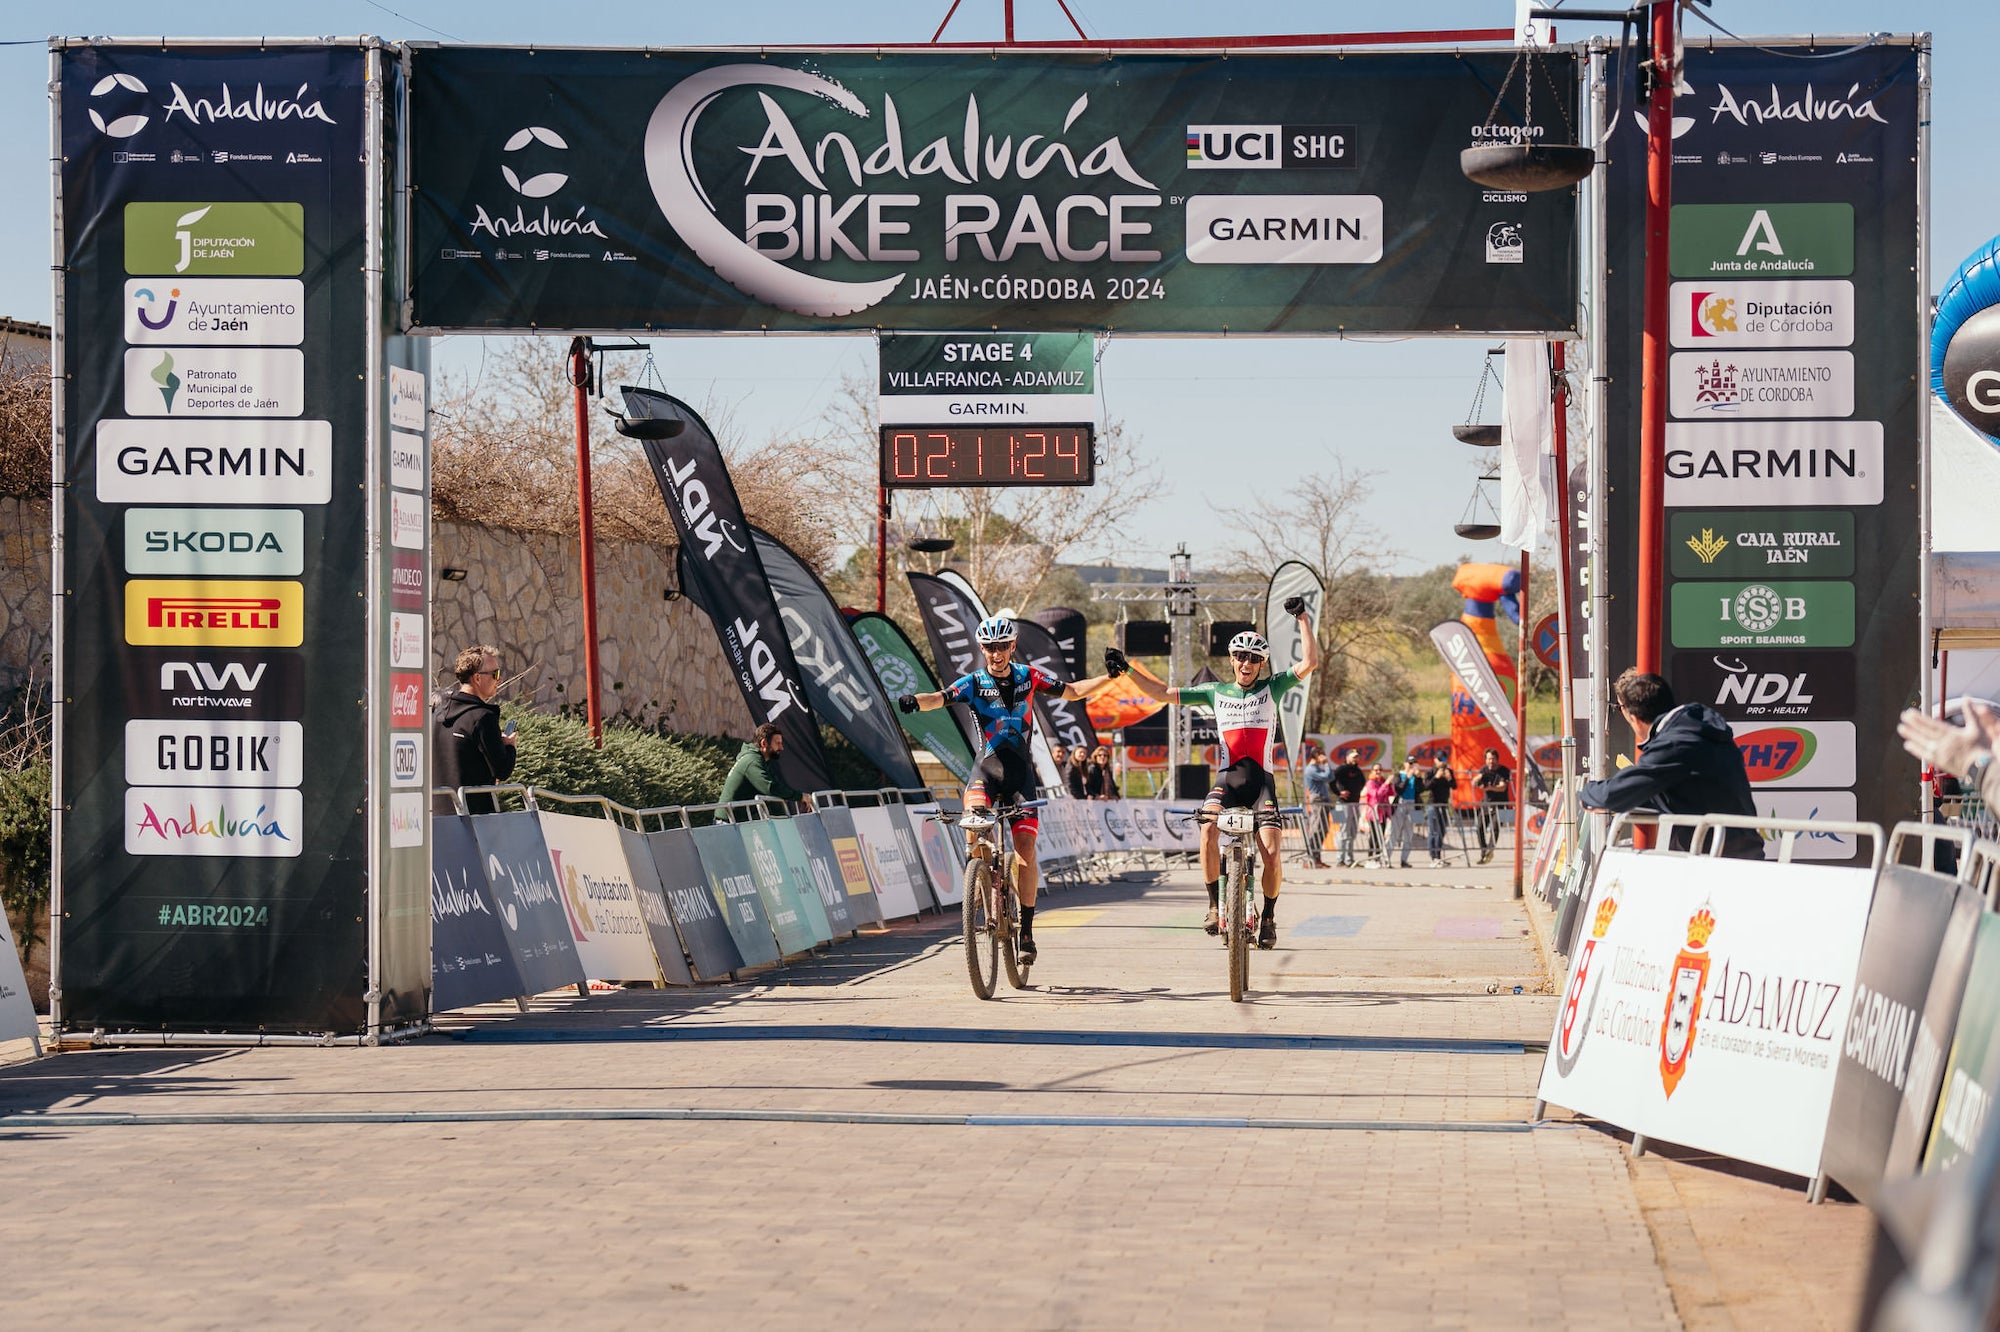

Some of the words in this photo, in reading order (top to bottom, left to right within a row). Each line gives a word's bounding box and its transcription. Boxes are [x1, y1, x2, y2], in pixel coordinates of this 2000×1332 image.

[163, 82, 337, 125] Andalucía
[1709, 82, 1888, 126] Andalucía
[738, 91, 1160, 191] Andalucía
[1471, 124, 1544, 145] octagon
[1203, 133, 1275, 161] UCI
[1293, 135, 1345, 159] SHC
[1482, 194, 1528, 203] CICLISMO
[469, 203, 609, 240] Andalucía
[745, 193, 920, 262] BIKE
[945, 194, 1162, 262] RACE
[1170, 196, 1185, 205] BY
[1209, 217, 1361, 241] GARMIN
[193, 236, 255, 247] DIPUTACIÓN
[193, 249, 208, 258] DE
[209, 247, 235, 258] JAÉN
[1710, 260, 1740, 271] Junta
[1744, 260, 1758, 271] de
[1760, 258, 1814, 271] Andalucía
[1107, 278, 1166, 300] 2024
[188, 300, 295, 317] Ayuntamiento
[1747, 302, 1832, 318] Diputación
[188, 318, 208, 331] de
[211, 318, 249, 331] Jaén
[1746, 319, 1764, 332] de
[1769, 319, 1833, 332] Córdoba
[943, 343, 1014, 361] STAGE
[1020, 343, 1033, 361] 4
[187, 370, 237, 380] Patronato
[1741, 366, 1831, 383] AYUNTAMIENTO
[187, 383, 237, 395] Municipal
[239, 383, 253, 394] de
[1740, 387, 1754, 402] DE
[187, 398, 234, 411] Deportes
[235, 399, 250, 409] de
[254, 398, 279, 409] Jaén
[949, 403, 1024, 415] GARMIN
[117, 447, 304, 476] GARMIN
[392, 450, 421, 471] GARMIN
[894, 433, 1079, 478] 02:11:24
[1665, 449, 1855, 478] GARMIN
[1736, 532, 1778, 547] CAJA
[1782, 532, 1840, 547] RURAL
[1767, 547, 1808, 564] JAÉN
[148, 597, 281, 628] PIRELLI
[1720, 636, 1753, 645] SPORT
[1756, 635, 1806, 645] BEARINGS
[1715, 673, 1814, 705] NDL
[173, 696, 252, 707] northwave
[1746, 706, 1766, 715] PRO
[1773, 706, 1809, 714] HEALTH
[158, 735, 269, 772] GOBIK
[395, 748, 414, 773] CRUZ
[136, 802, 291, 841] Andalucía
[1227, 816, 1244, 828] 4-1
[583, 874, 632, 904] Diputación
[158, 904, 269, 927] #ABR2024
[667, 886, 717, 924] GARMIN
[1706, 957, 1841, 1041] ADAMUZ
[1846, 983, 1916, 1090] GARMIN
